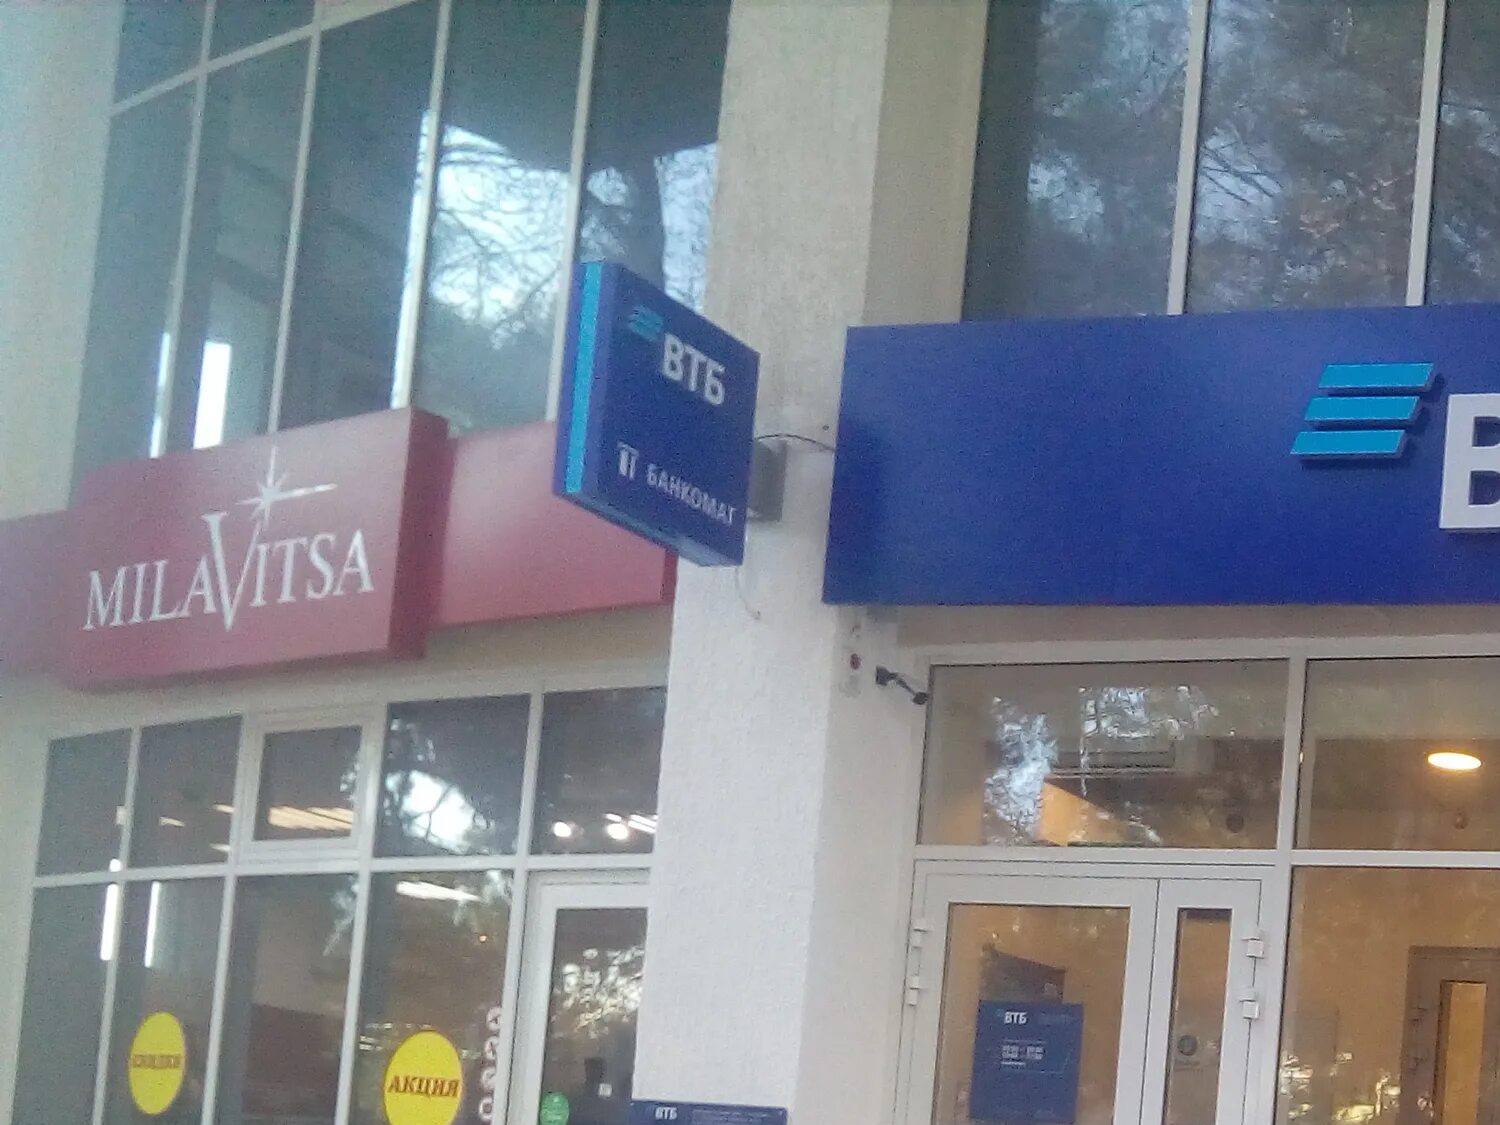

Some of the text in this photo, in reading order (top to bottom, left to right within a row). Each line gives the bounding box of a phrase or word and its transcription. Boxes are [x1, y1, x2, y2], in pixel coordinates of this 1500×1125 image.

[663, 332, 726, 406] ВТБ
[646, 463, 737, 527] БАНКОМАТ
[80, 510, 375, 633] MILAVITSA
[1003, 1011, 1028, 1024] ВТБ
[387, 1075, 461, 1099] АКЦИЯ
[654, 1106, 679, 1121] ВТБ
